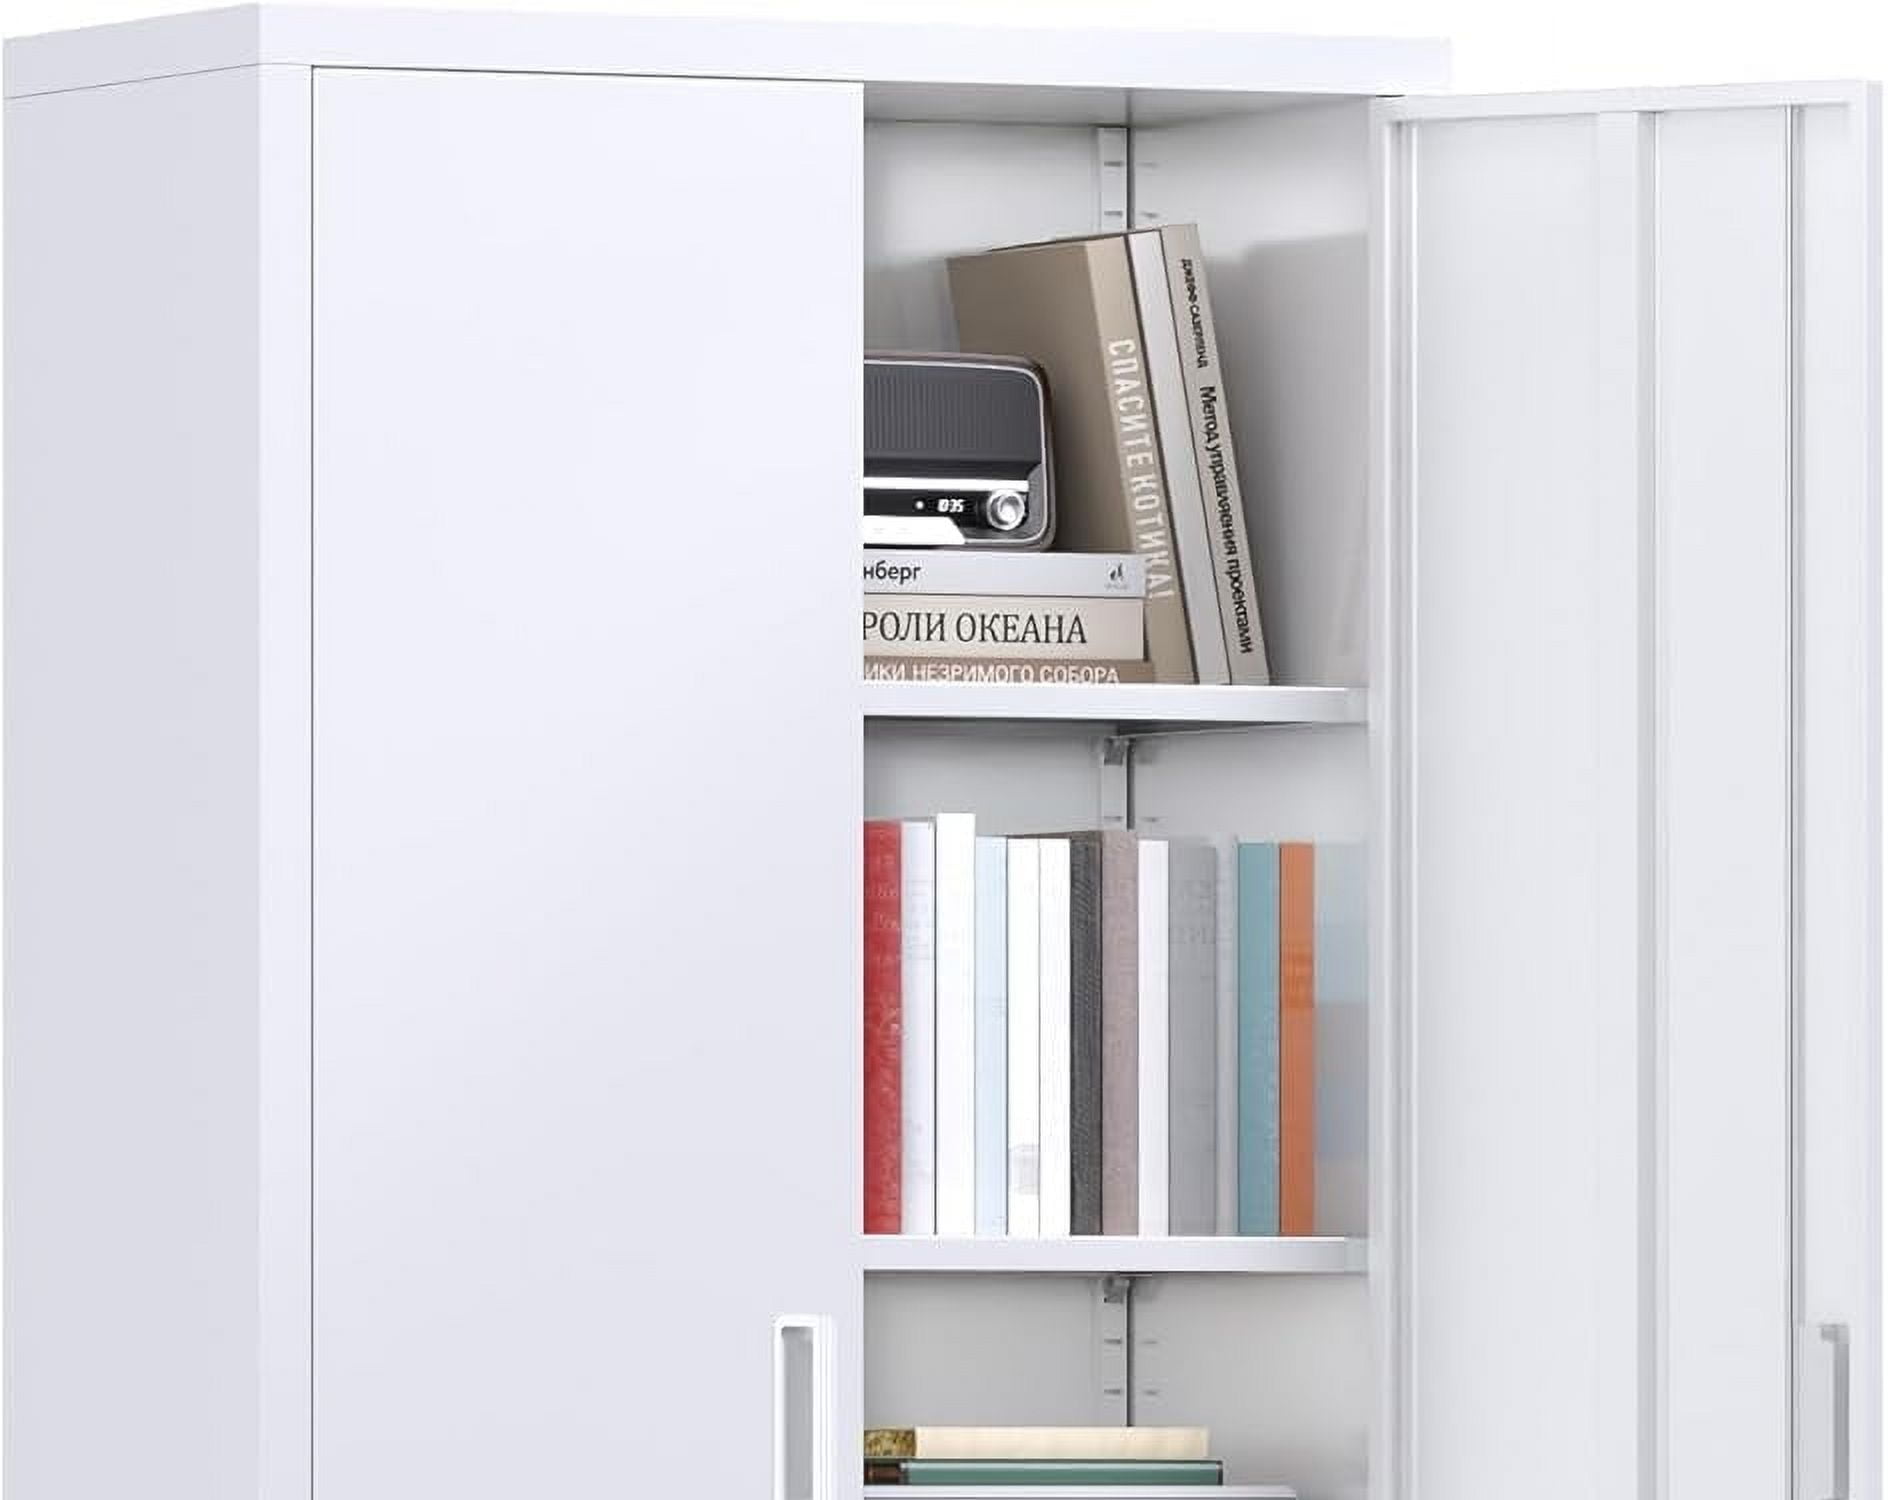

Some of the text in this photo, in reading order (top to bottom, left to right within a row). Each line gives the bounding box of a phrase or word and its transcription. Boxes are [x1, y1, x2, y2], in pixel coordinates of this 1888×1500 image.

[1107, 338, 1174, 600] СПАСИТЕ КОТИКА!
[1200, 385, 1220, 443] Метод
[1226, 557, 1254, 655] проектами
[863, 559, 921, 585] нберг
[863, 611, 1087, 644] РОЛИ ОКЕАНА
[864, 663, 1120, 686] ИКИ НЕЗРИМОГО СОБОРА
